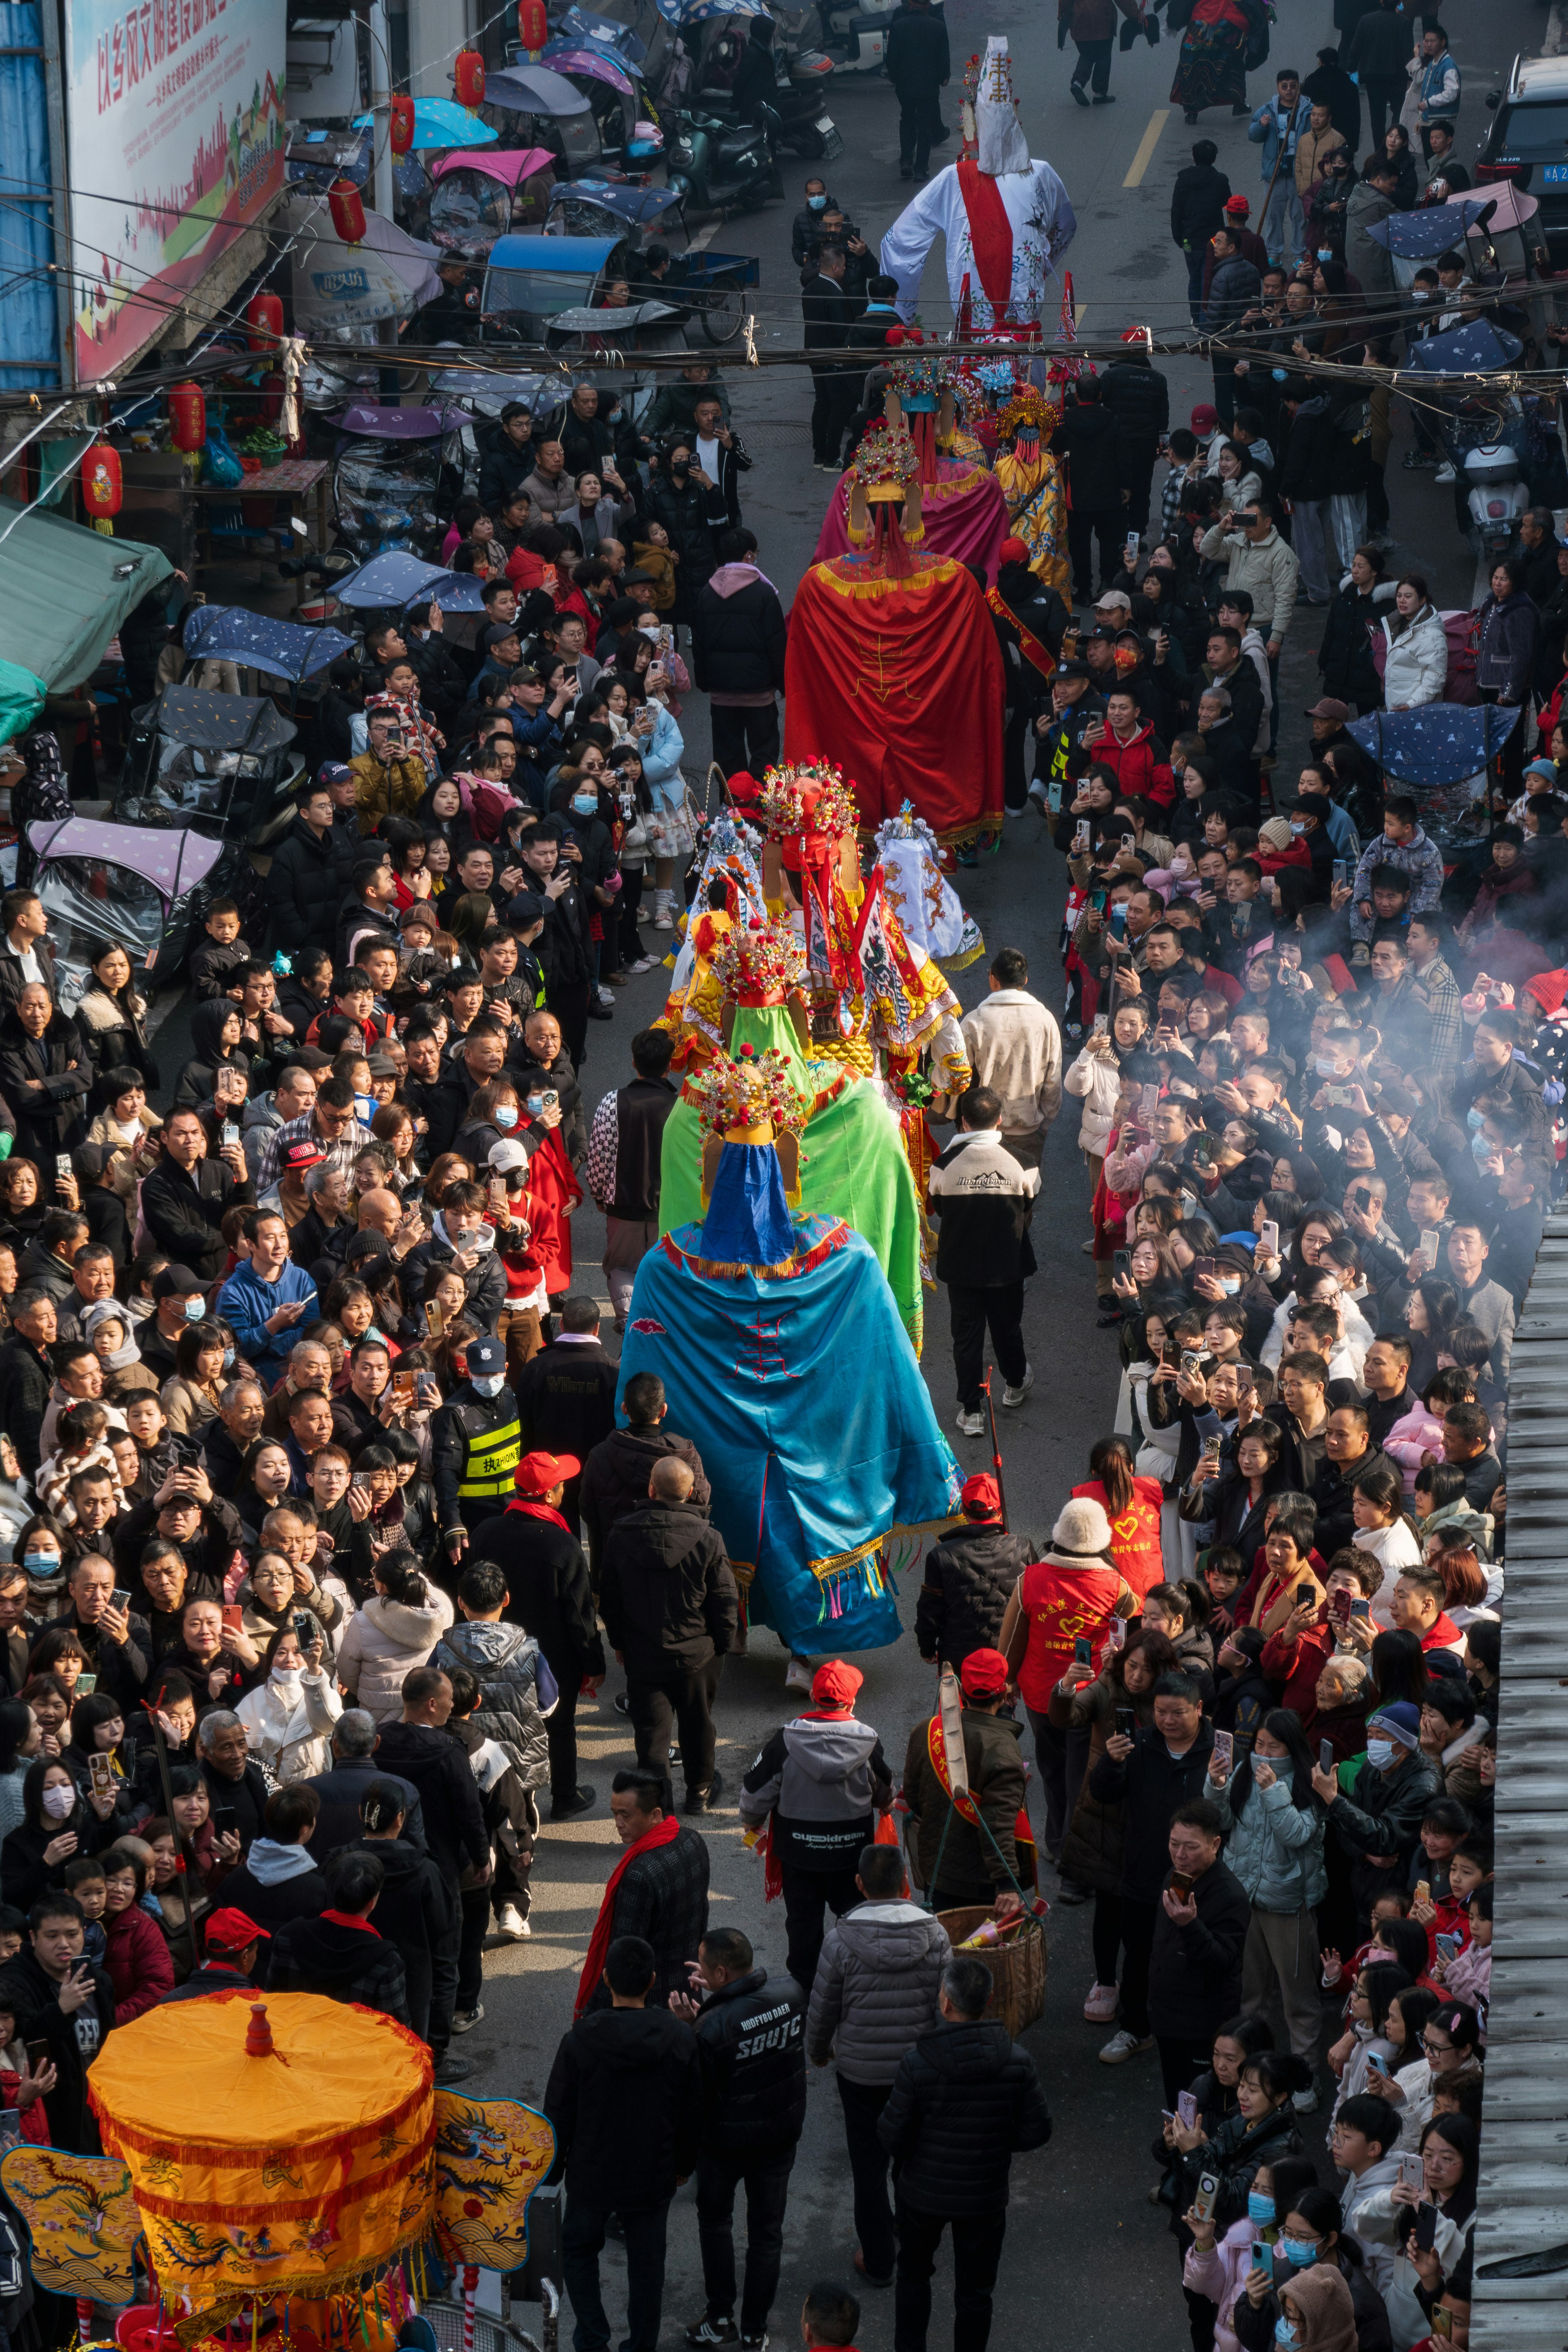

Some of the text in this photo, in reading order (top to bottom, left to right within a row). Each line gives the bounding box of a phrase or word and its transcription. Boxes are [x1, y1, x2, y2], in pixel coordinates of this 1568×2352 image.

[957, 1177, 1011, 1188] HuangDown
[496, 1452, 515, 1468] ZHIQIN
[792, 1832, 866, 1843] cupidream
[772, 2003, 791, 2021] DAER
